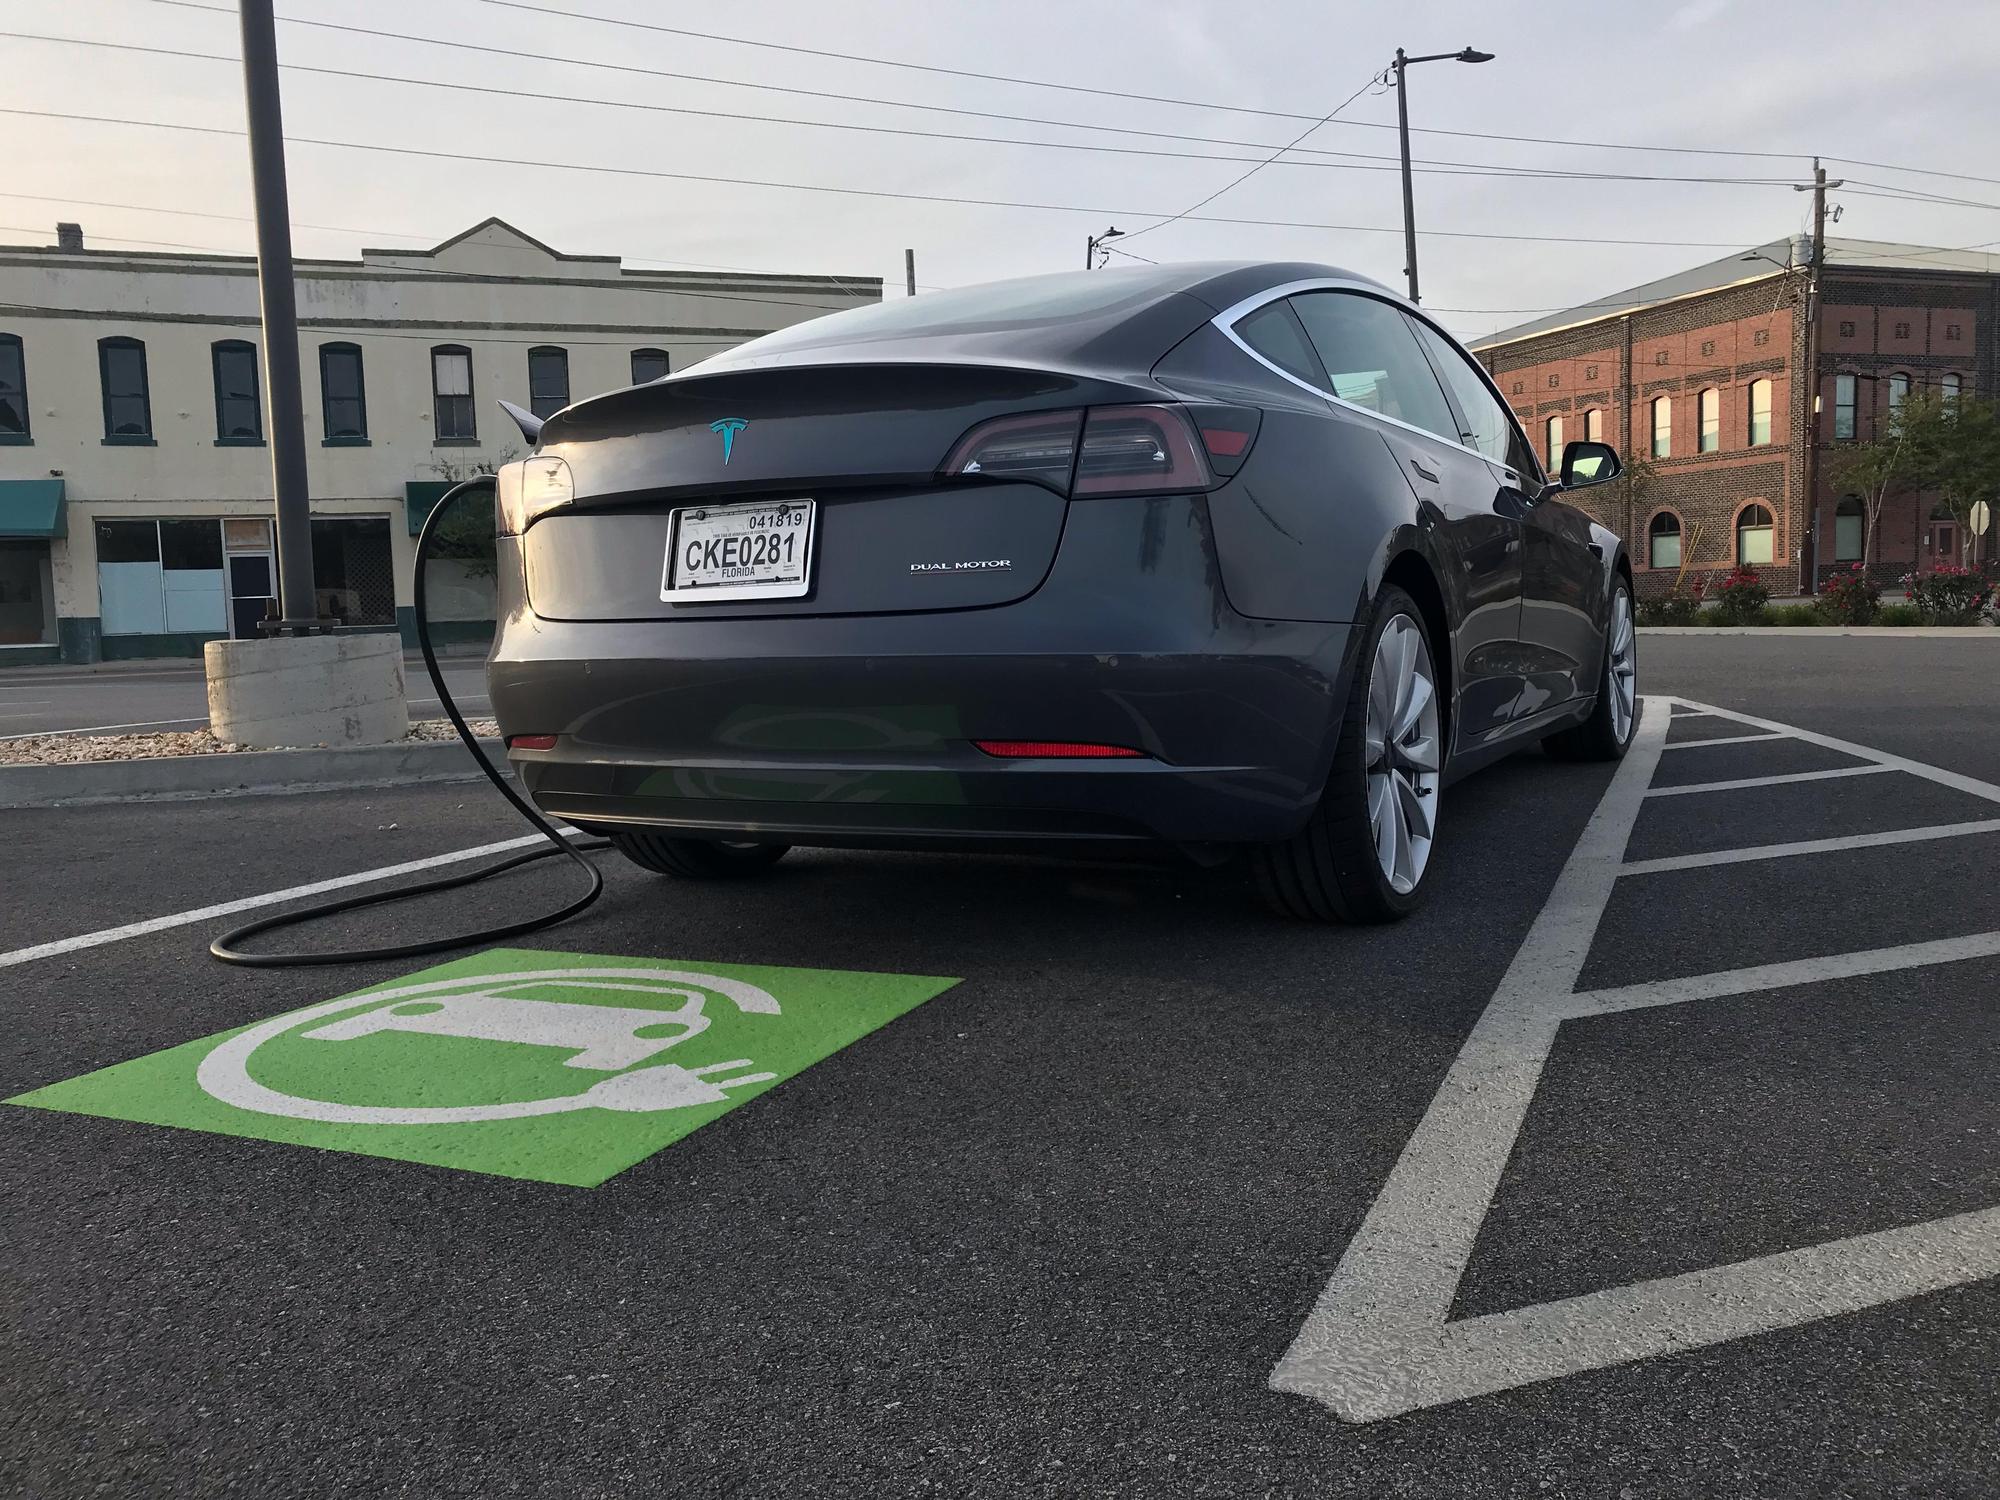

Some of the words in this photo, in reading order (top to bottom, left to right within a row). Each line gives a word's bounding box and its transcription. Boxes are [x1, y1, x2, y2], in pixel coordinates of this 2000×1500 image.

[750, 513, 802, 529] 041819
[686, 532, 795, 571] CKE0281
[910, 562, 952, 571] DUAL
[955, 560, 1011, 569] MOTOR
[722, 567, 755, 578] FLORIDA
